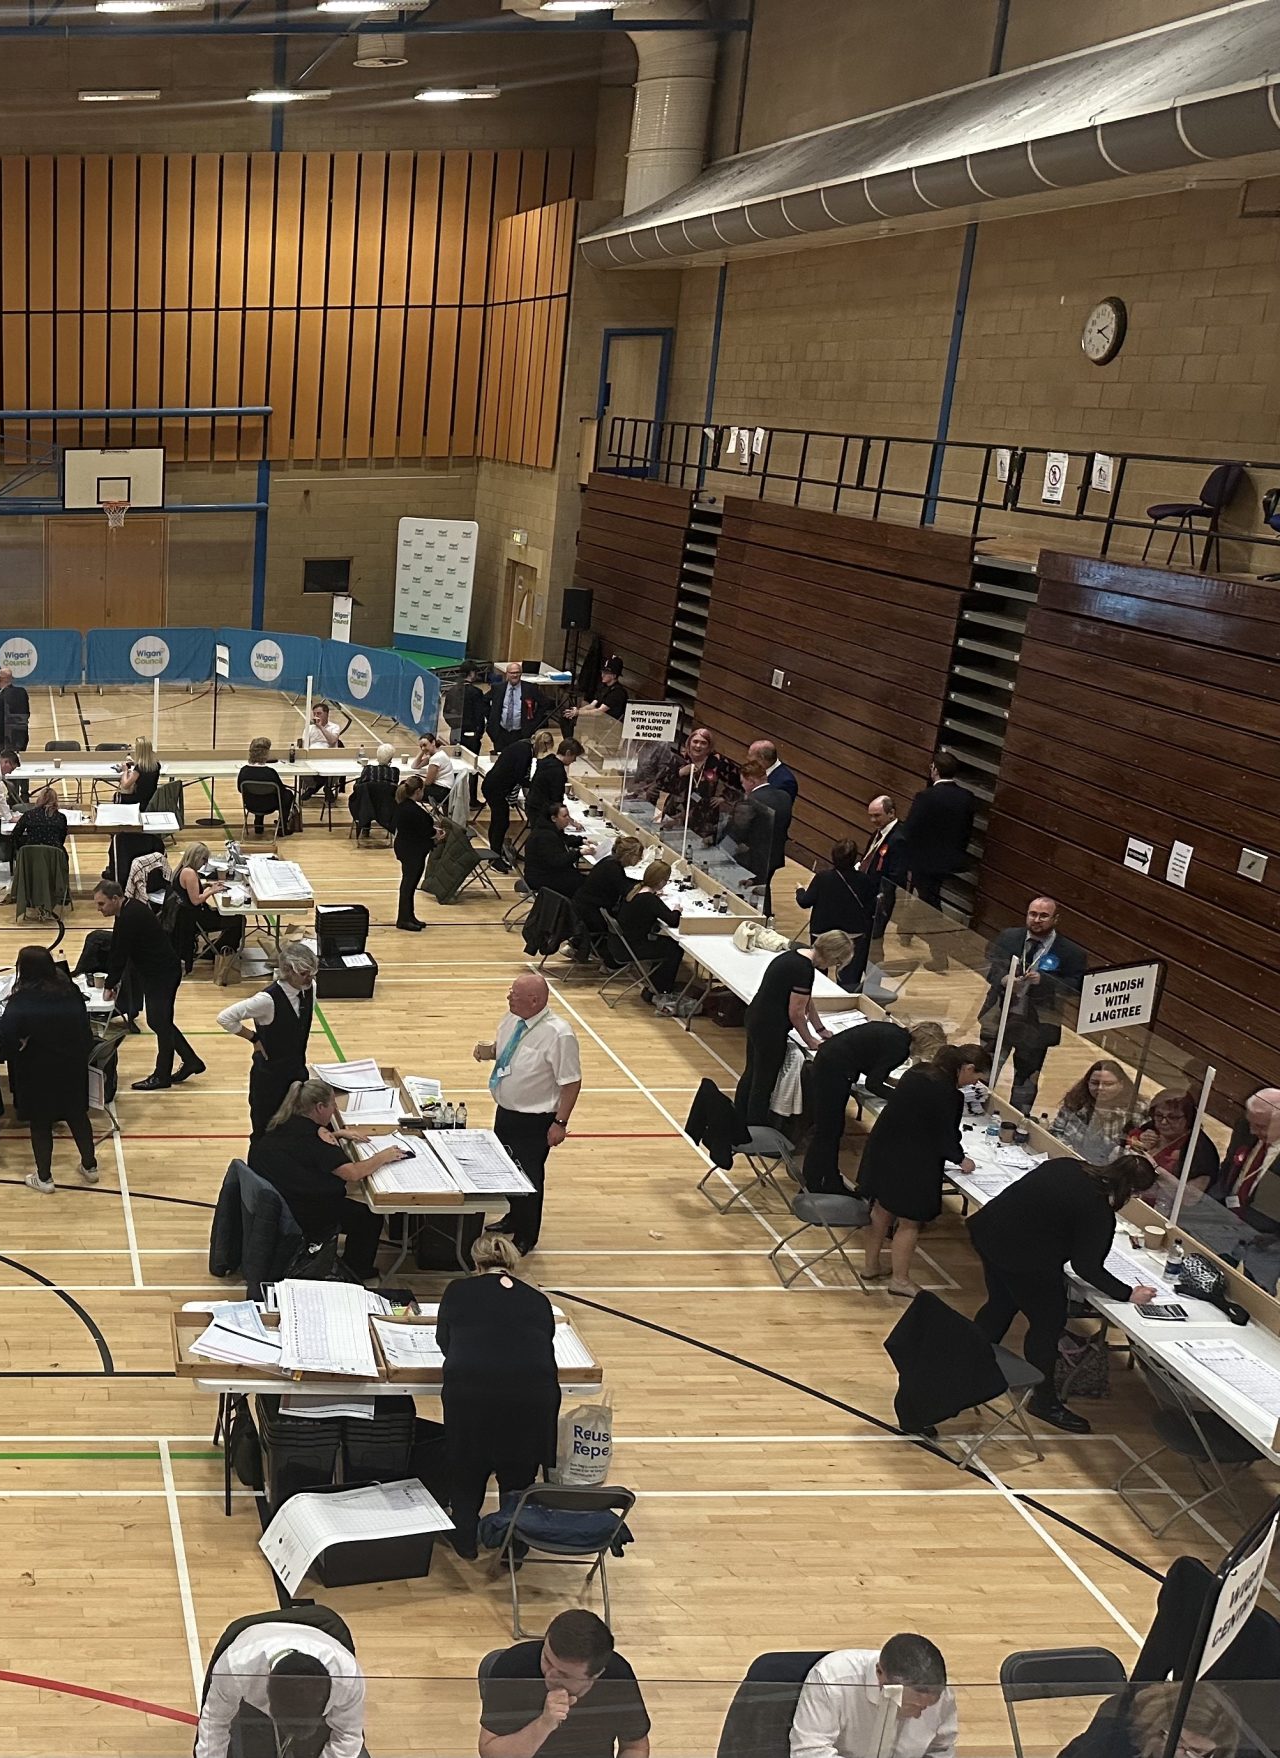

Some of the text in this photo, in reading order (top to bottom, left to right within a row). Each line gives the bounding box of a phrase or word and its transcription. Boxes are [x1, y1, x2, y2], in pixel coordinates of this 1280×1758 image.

[4, 651, 30, 660] Wigan
[136, 649, 162, 659] Wigan
[255, 652, 277, 663] Wigan
[2, 659, 31, 667] Council
[134, 657, 163, 665] Council
[253, 660, 278, 670] Council
[631, 709, 673, 718] SHEVINGTON
[1093, 977, 1145, 996] STANDISH
[1105, 993, 1131, 1007] WITH
[1089, 1004, 1142, 1023] LANGTREE
